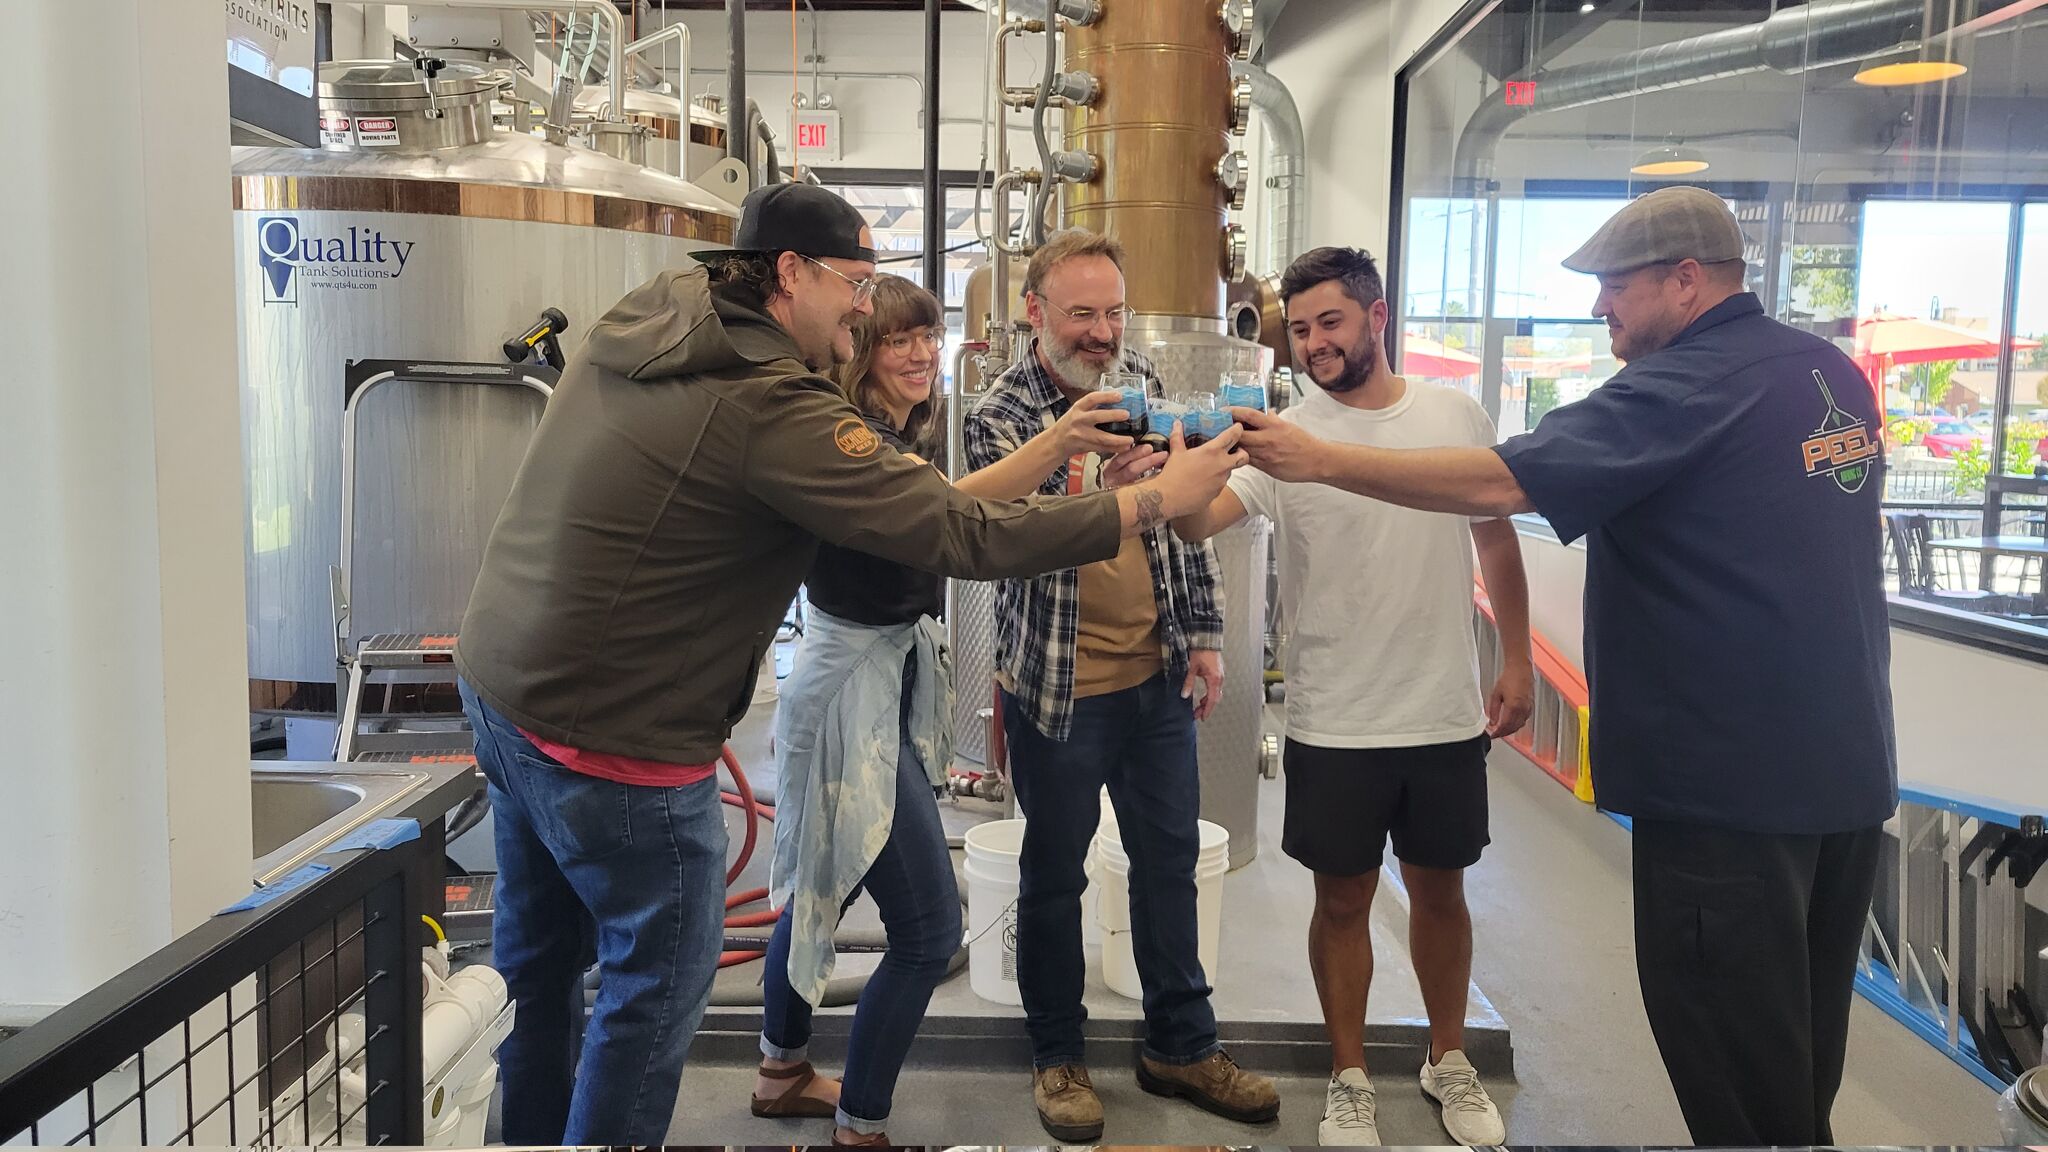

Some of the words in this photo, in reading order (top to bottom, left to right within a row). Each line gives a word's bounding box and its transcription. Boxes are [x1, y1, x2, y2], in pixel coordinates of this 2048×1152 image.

[225, 2, 288, 41] SSOCIATION
[248, 0, 309, 32] IRITS
[1506, 81, 1536, 105] EXIT
[363, 121, 390, 129] DANGER
[799, 124, 827, 147] EXIT
[260, 219, 416, 278] Quality
[299, 265, 329, 277] Tank
[331, 265, 390, 279] Solutions
[311, 281, 378, 290] www.qts4u.com
[1801, 426, 1879, 473] PEEL
